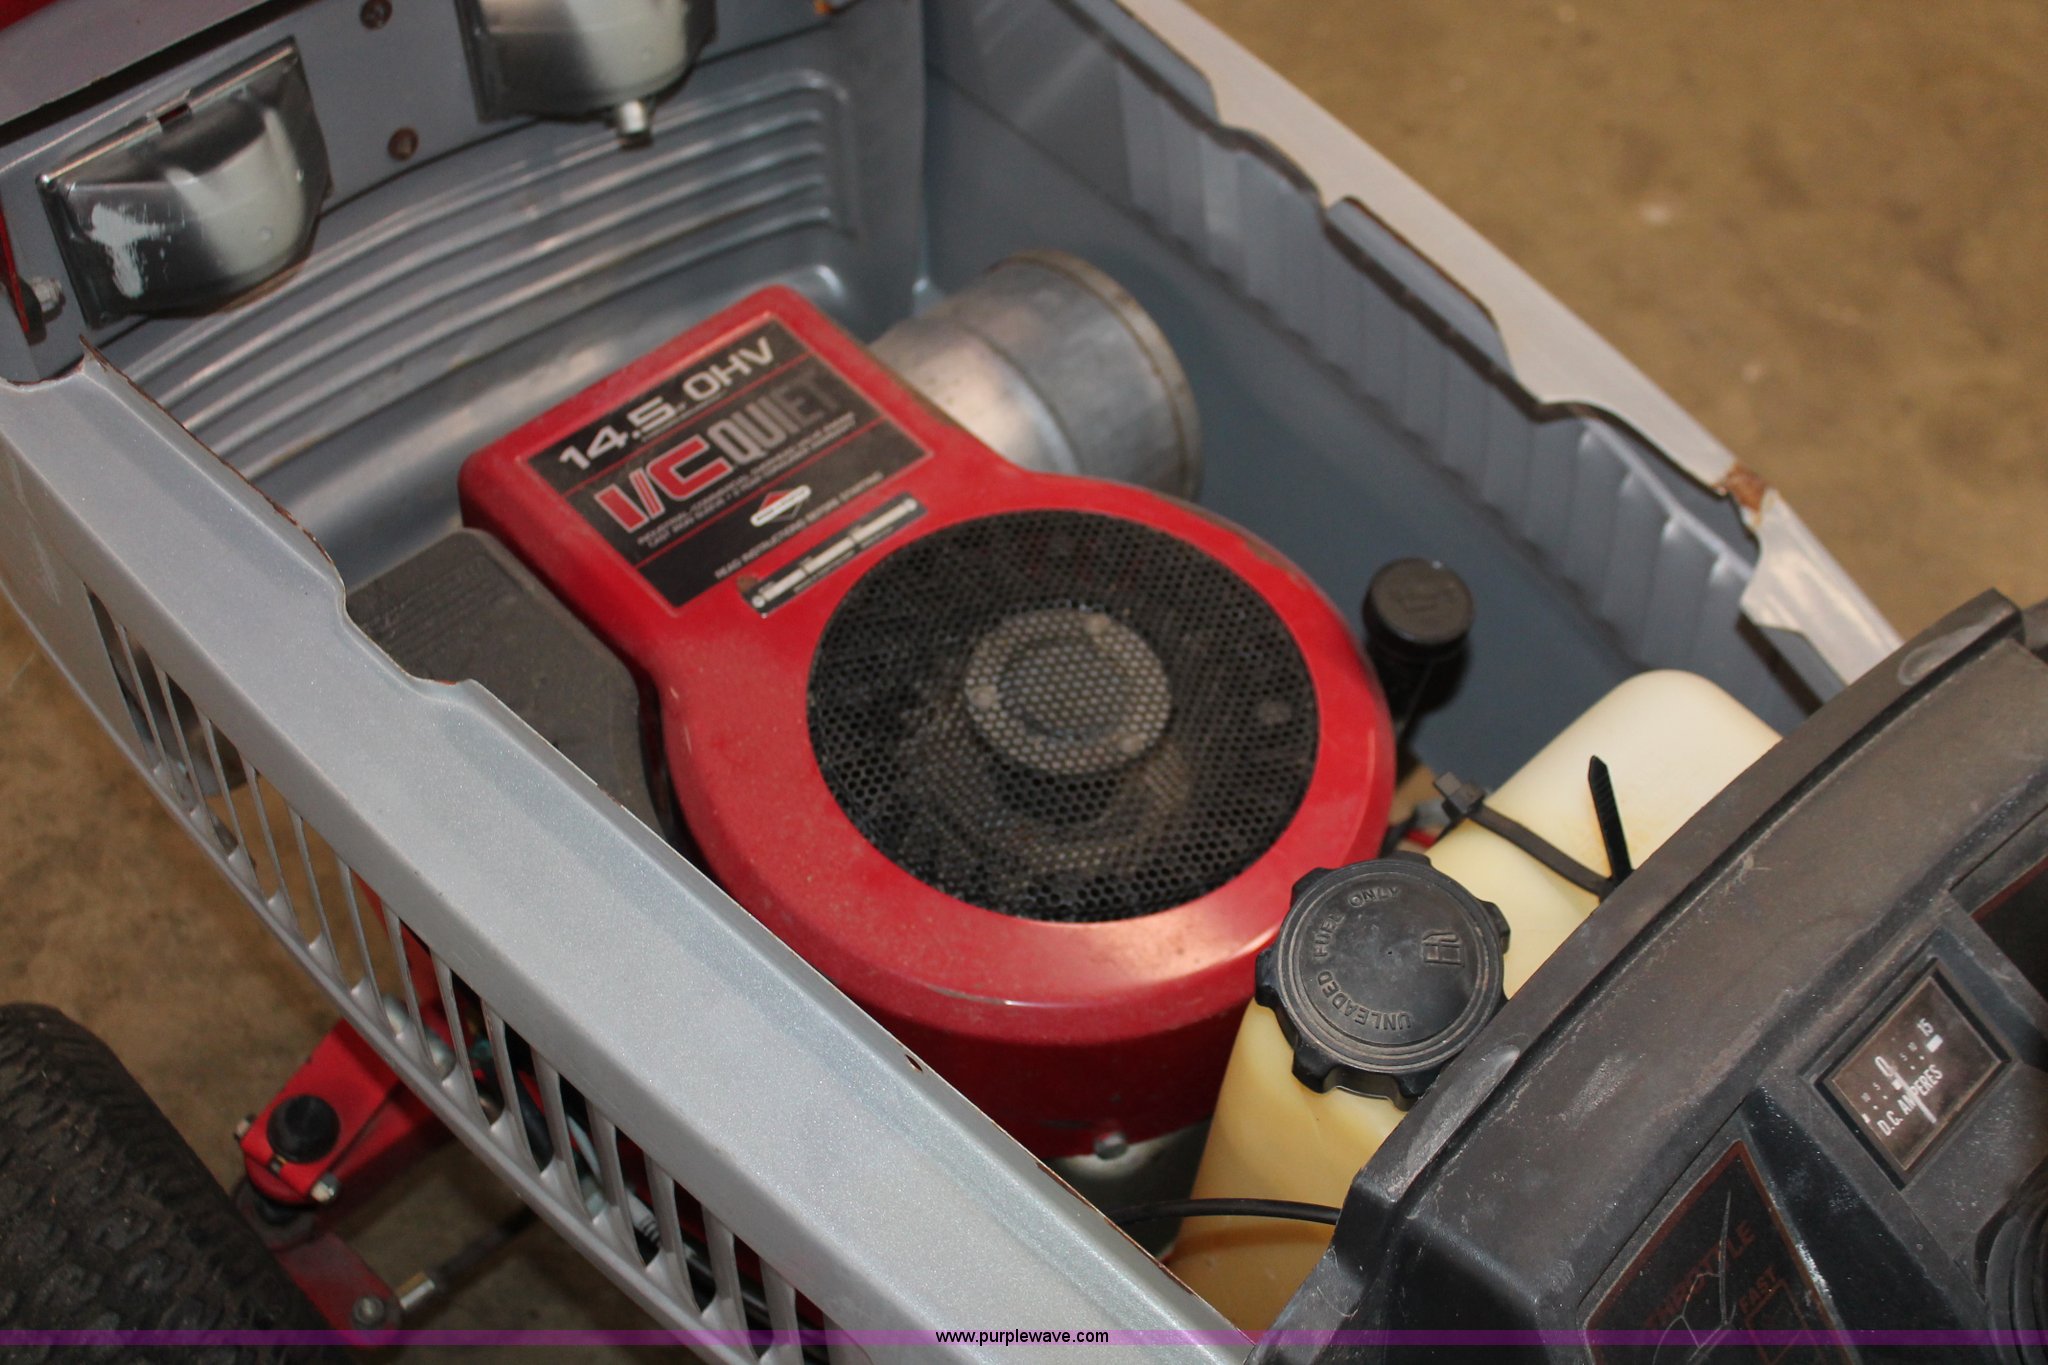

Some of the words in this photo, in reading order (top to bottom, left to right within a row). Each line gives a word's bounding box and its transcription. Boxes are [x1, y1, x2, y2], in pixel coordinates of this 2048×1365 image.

[558, 394, 678, 471] 14.5
[681, 335, 776, 402] OHV
[705, 368, 846, 465] QUIET
[1349, 886, 1400, 907] ONLY
[1314, 912, 1345, 960] FUEL
[1317, 969, 1413, 1031] UNLEADED
[1897, 1064, 1943, 1115] AMPERES
